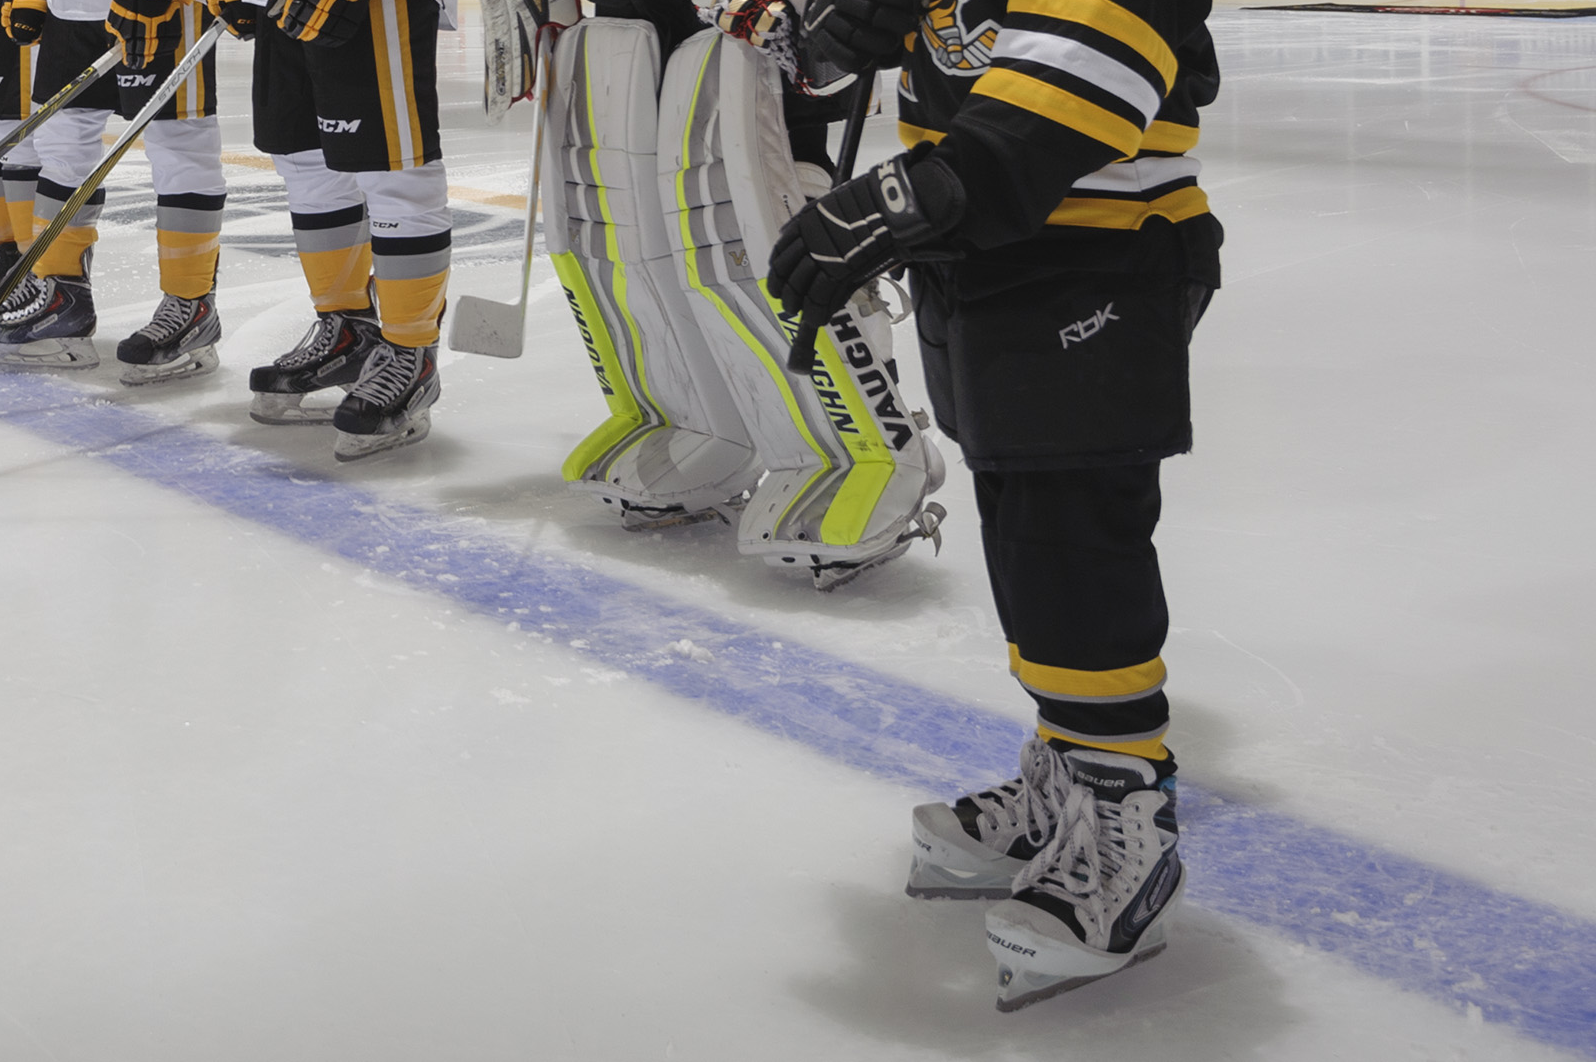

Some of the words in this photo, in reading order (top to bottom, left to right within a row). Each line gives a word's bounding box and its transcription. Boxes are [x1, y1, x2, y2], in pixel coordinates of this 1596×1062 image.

[157, 48, 202, 103] STEALTH
[561, 284, 615, 397] VAUGHN
[1076, 769, 1126, 788] BAUER
